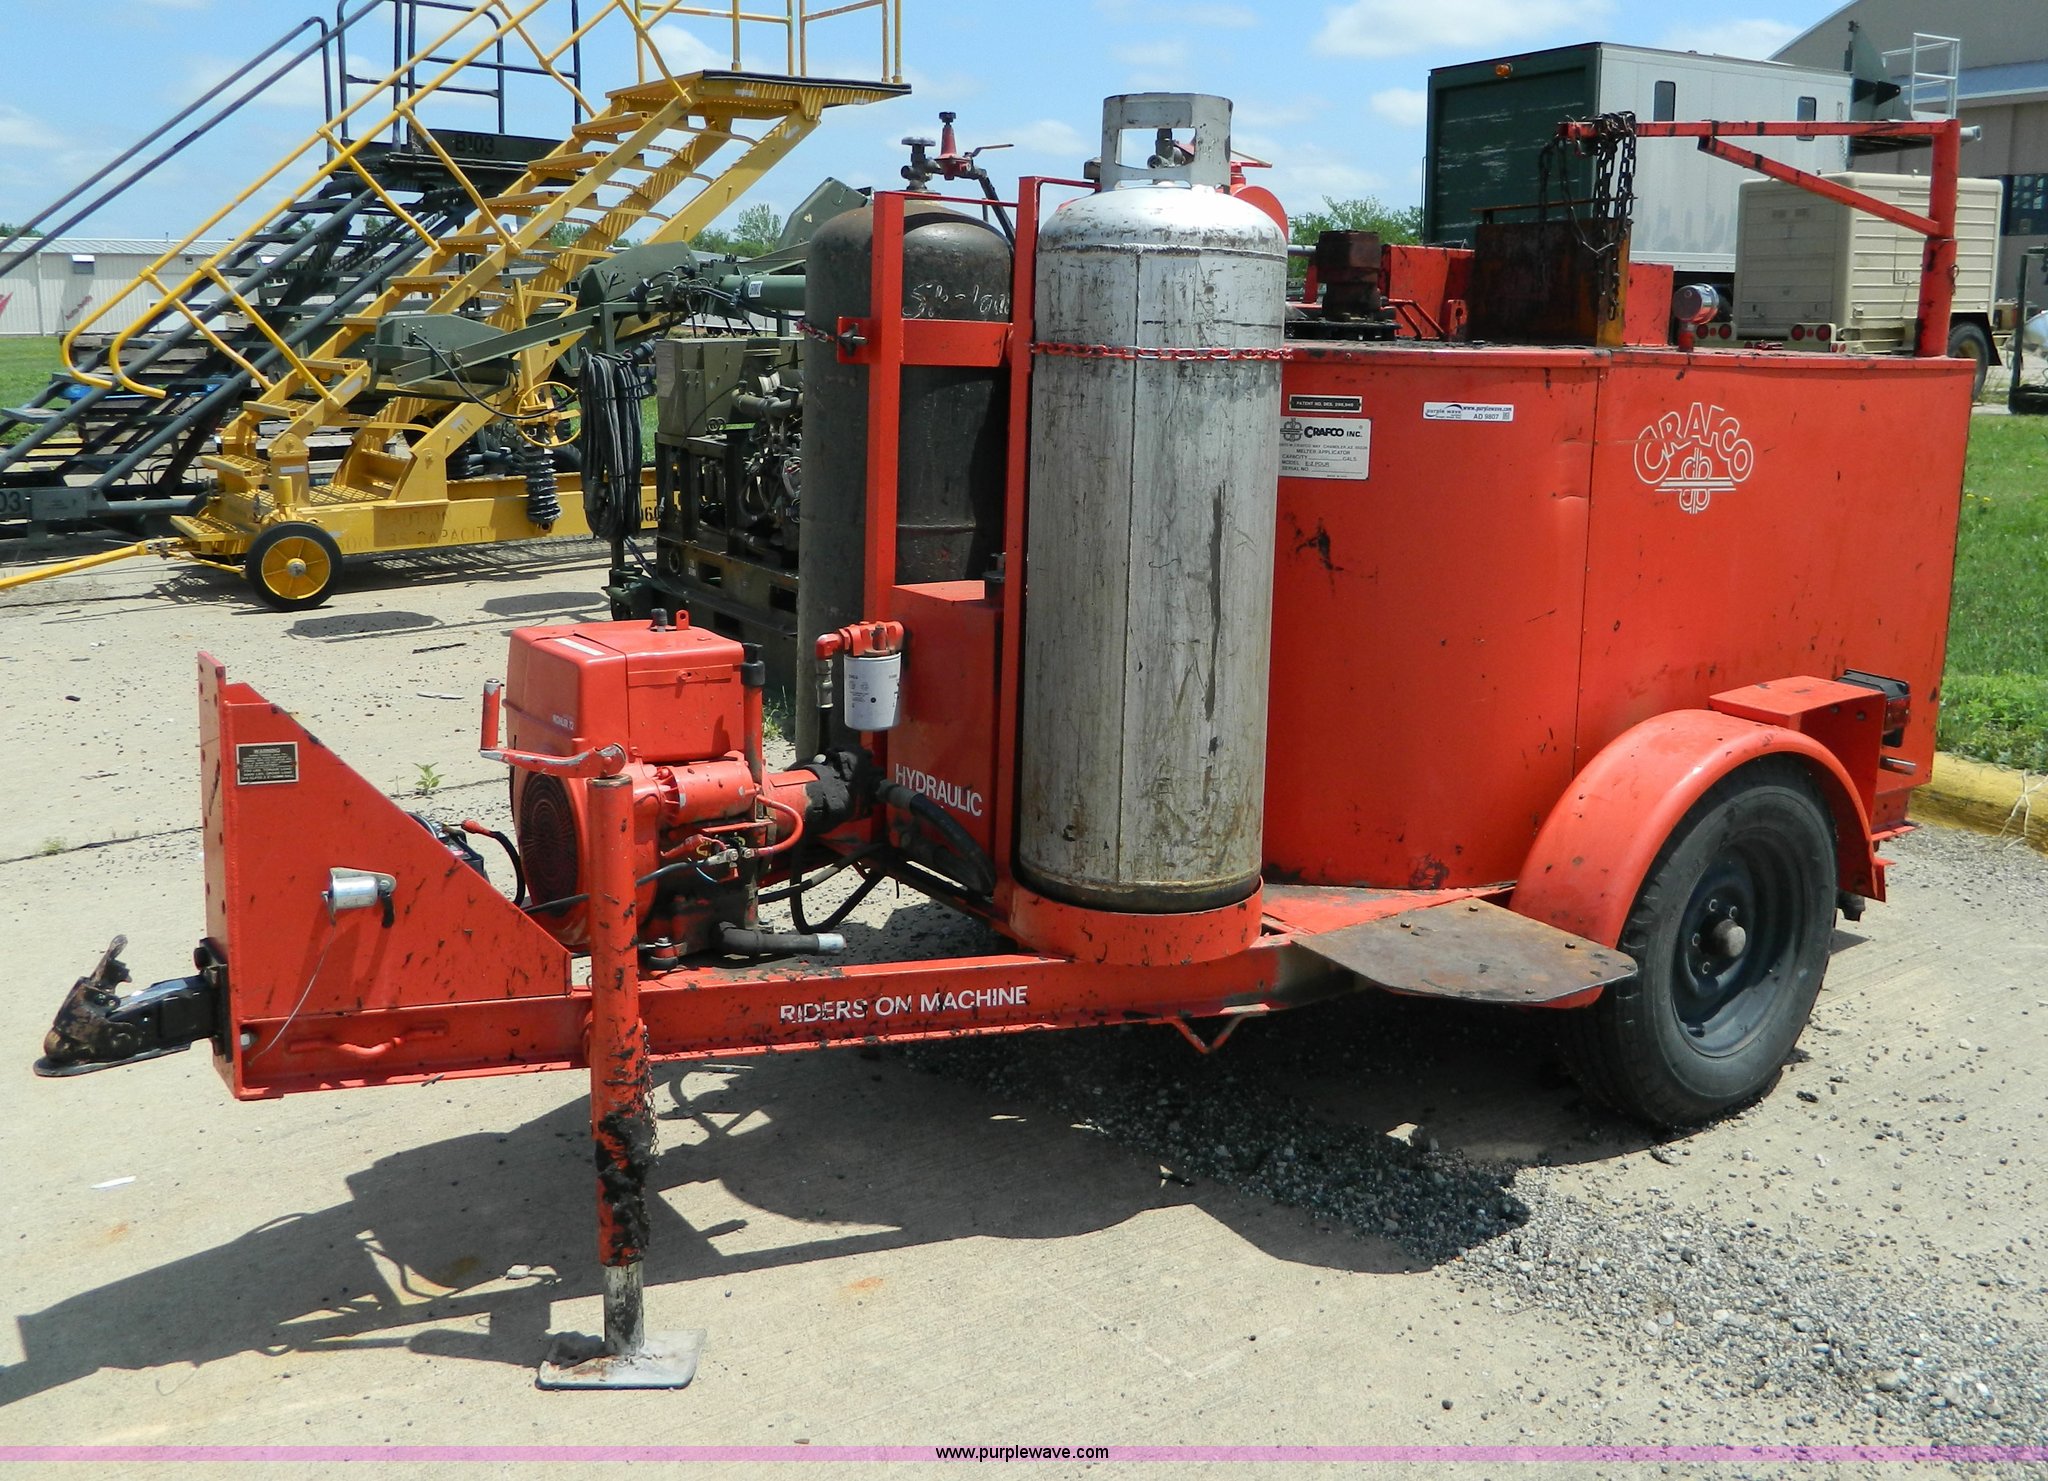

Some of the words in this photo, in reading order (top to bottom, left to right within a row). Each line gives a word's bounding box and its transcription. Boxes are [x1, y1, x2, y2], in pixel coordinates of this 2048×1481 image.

[1304, 426, 1344, 438] CRAFCO
[1634, 401, 1754, 485] CRAFCO
[895, 763, 982, 817] HYDRAULIC
[779, 999, 868, 1025] RIDERS
[874, 995, 912, 1017] ON
[920, 985, 1029, 1013] MACHINE
